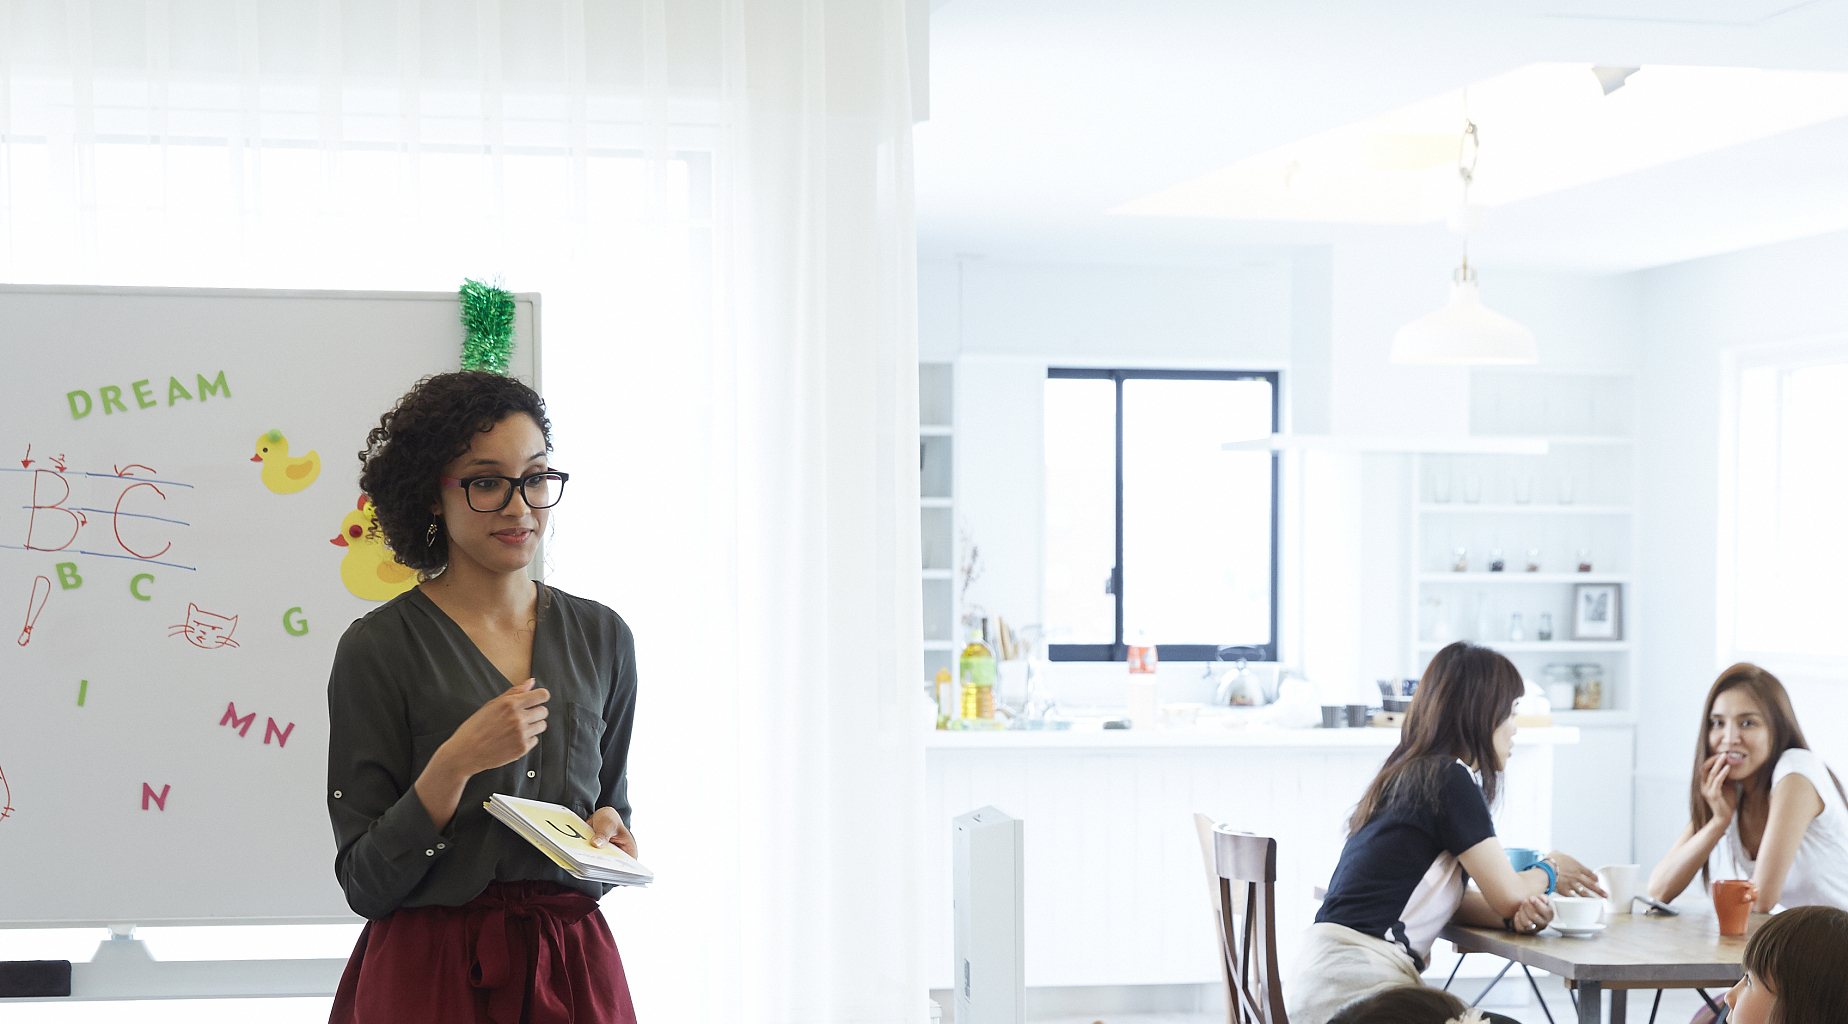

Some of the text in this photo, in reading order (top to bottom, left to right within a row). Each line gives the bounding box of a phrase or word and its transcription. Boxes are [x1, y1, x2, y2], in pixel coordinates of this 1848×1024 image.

[66, 370, 232, 420] DREAM
[56, 561, 155, 601] B C
[282, 606, 309, 636] G
[77, 679, 88, 707] I
[141, 782, 171, 811] N
